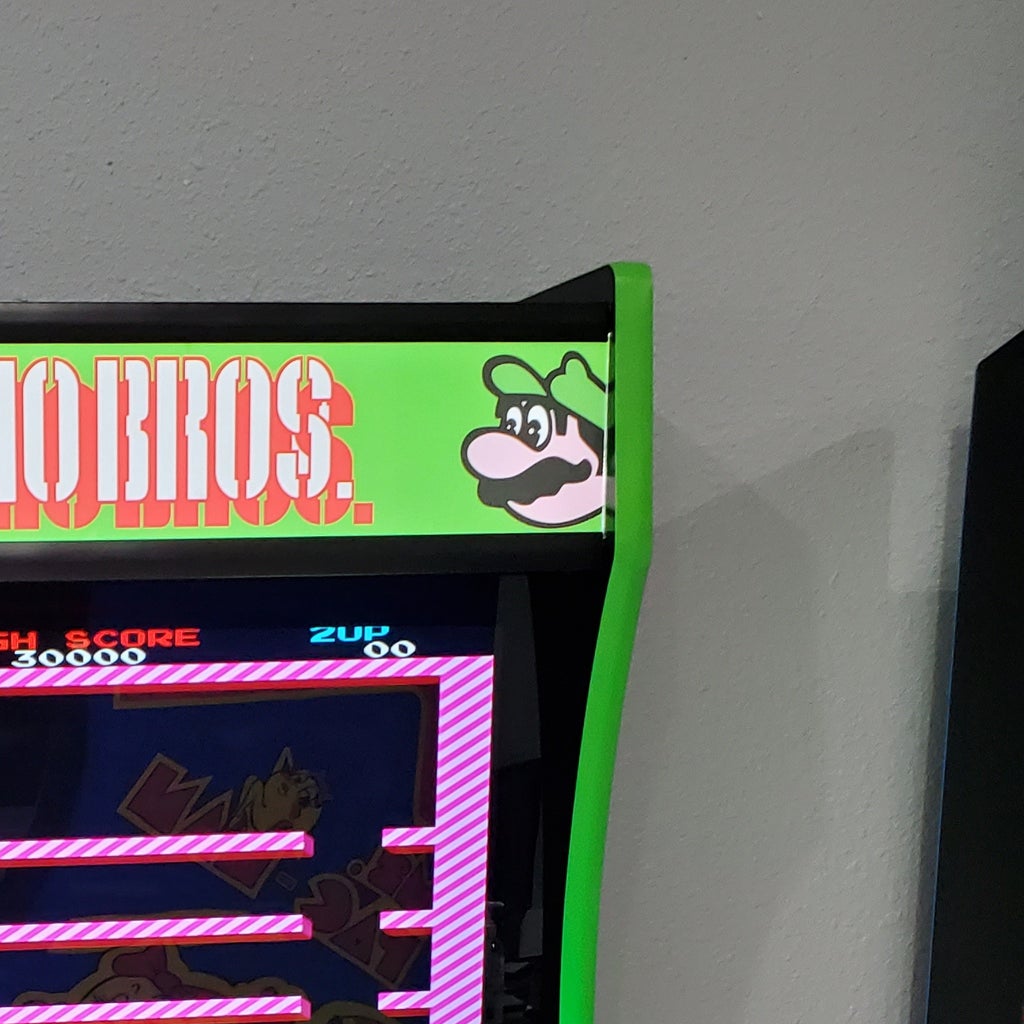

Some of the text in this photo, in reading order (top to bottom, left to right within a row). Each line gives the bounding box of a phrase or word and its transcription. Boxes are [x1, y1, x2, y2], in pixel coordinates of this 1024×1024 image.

[94, 355, 361, 516] BROS.
[65, 628, 201, 648] SCORE
[310, 626, 390, 643] 2UP
[11, 648, 146, 668] 30000
